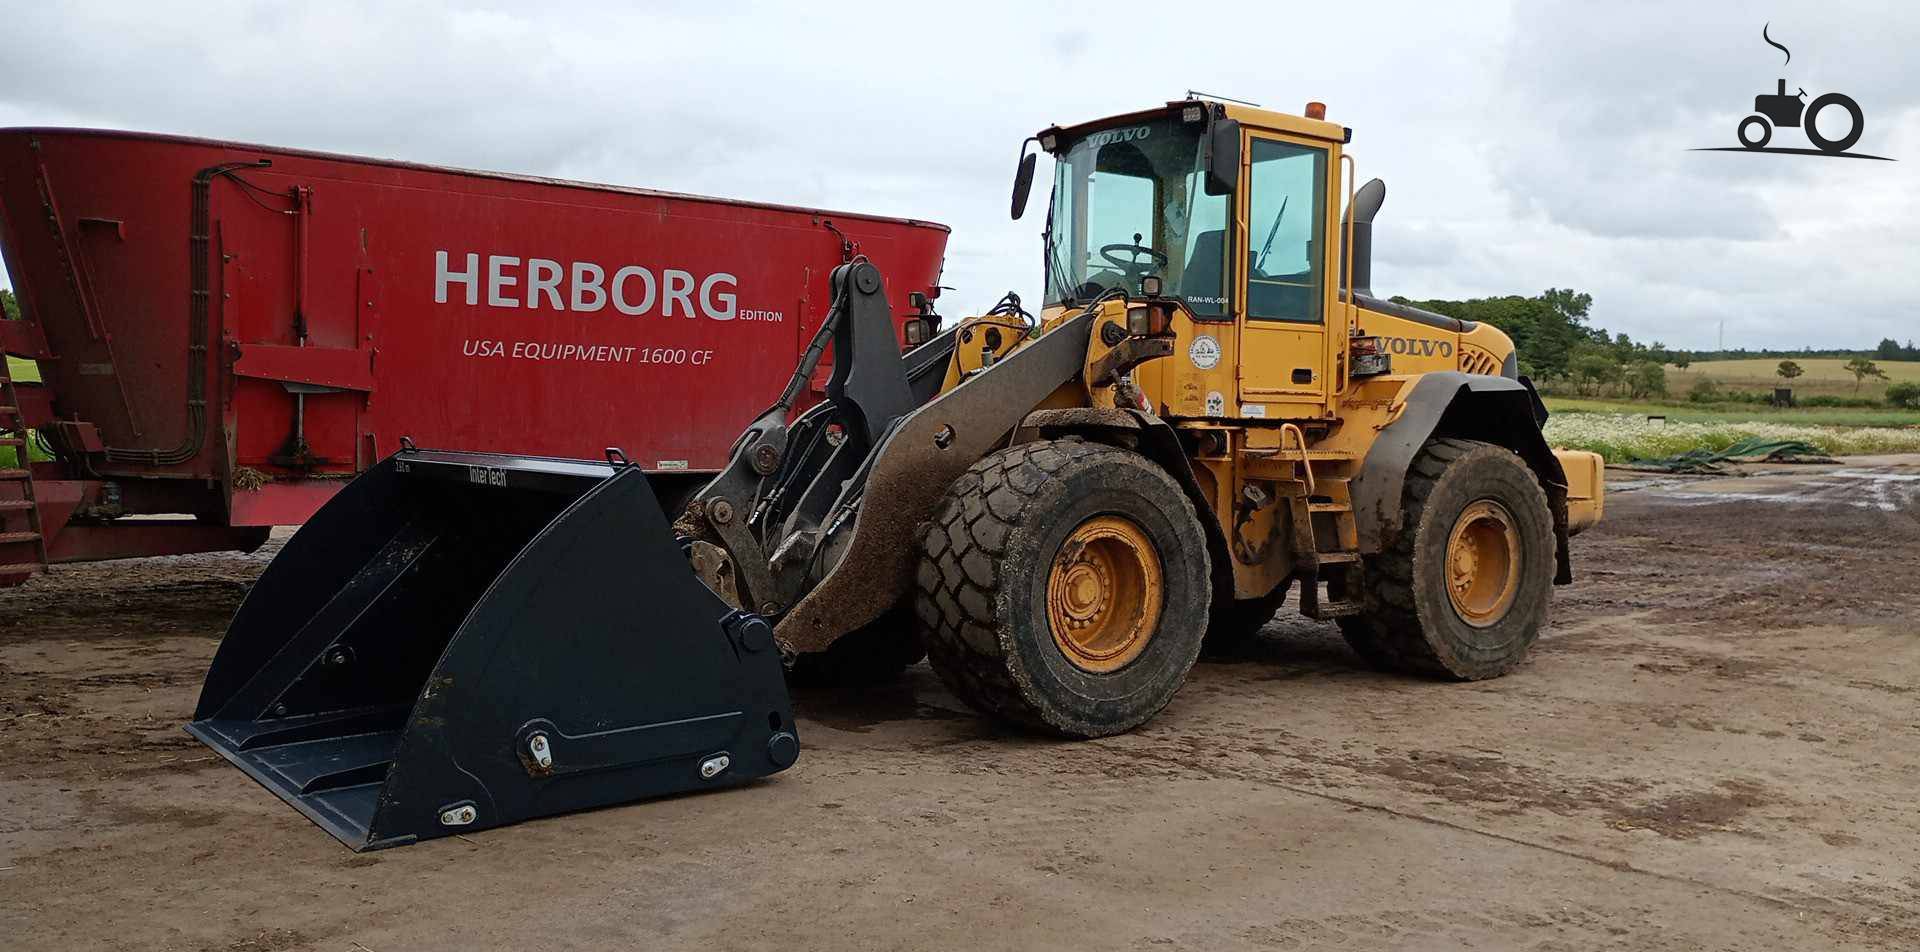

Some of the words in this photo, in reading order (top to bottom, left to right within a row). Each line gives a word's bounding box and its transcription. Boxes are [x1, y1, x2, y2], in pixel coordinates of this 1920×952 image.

[1086, 126, 1151, 148] VOLVO
[435, 251, 737, 321] HERBORG
[739, 309, 783, 322] EDITION
[463, 340, 505, 357] USA
[512, 343, 636, 363] EQUIPMENT
[639, 348, 686, 365] 1600
[691, 350, 714, 365] CF
[1375, 336, 1453, 358] VOLVO
[469, 466, 507, 487] InterTech
